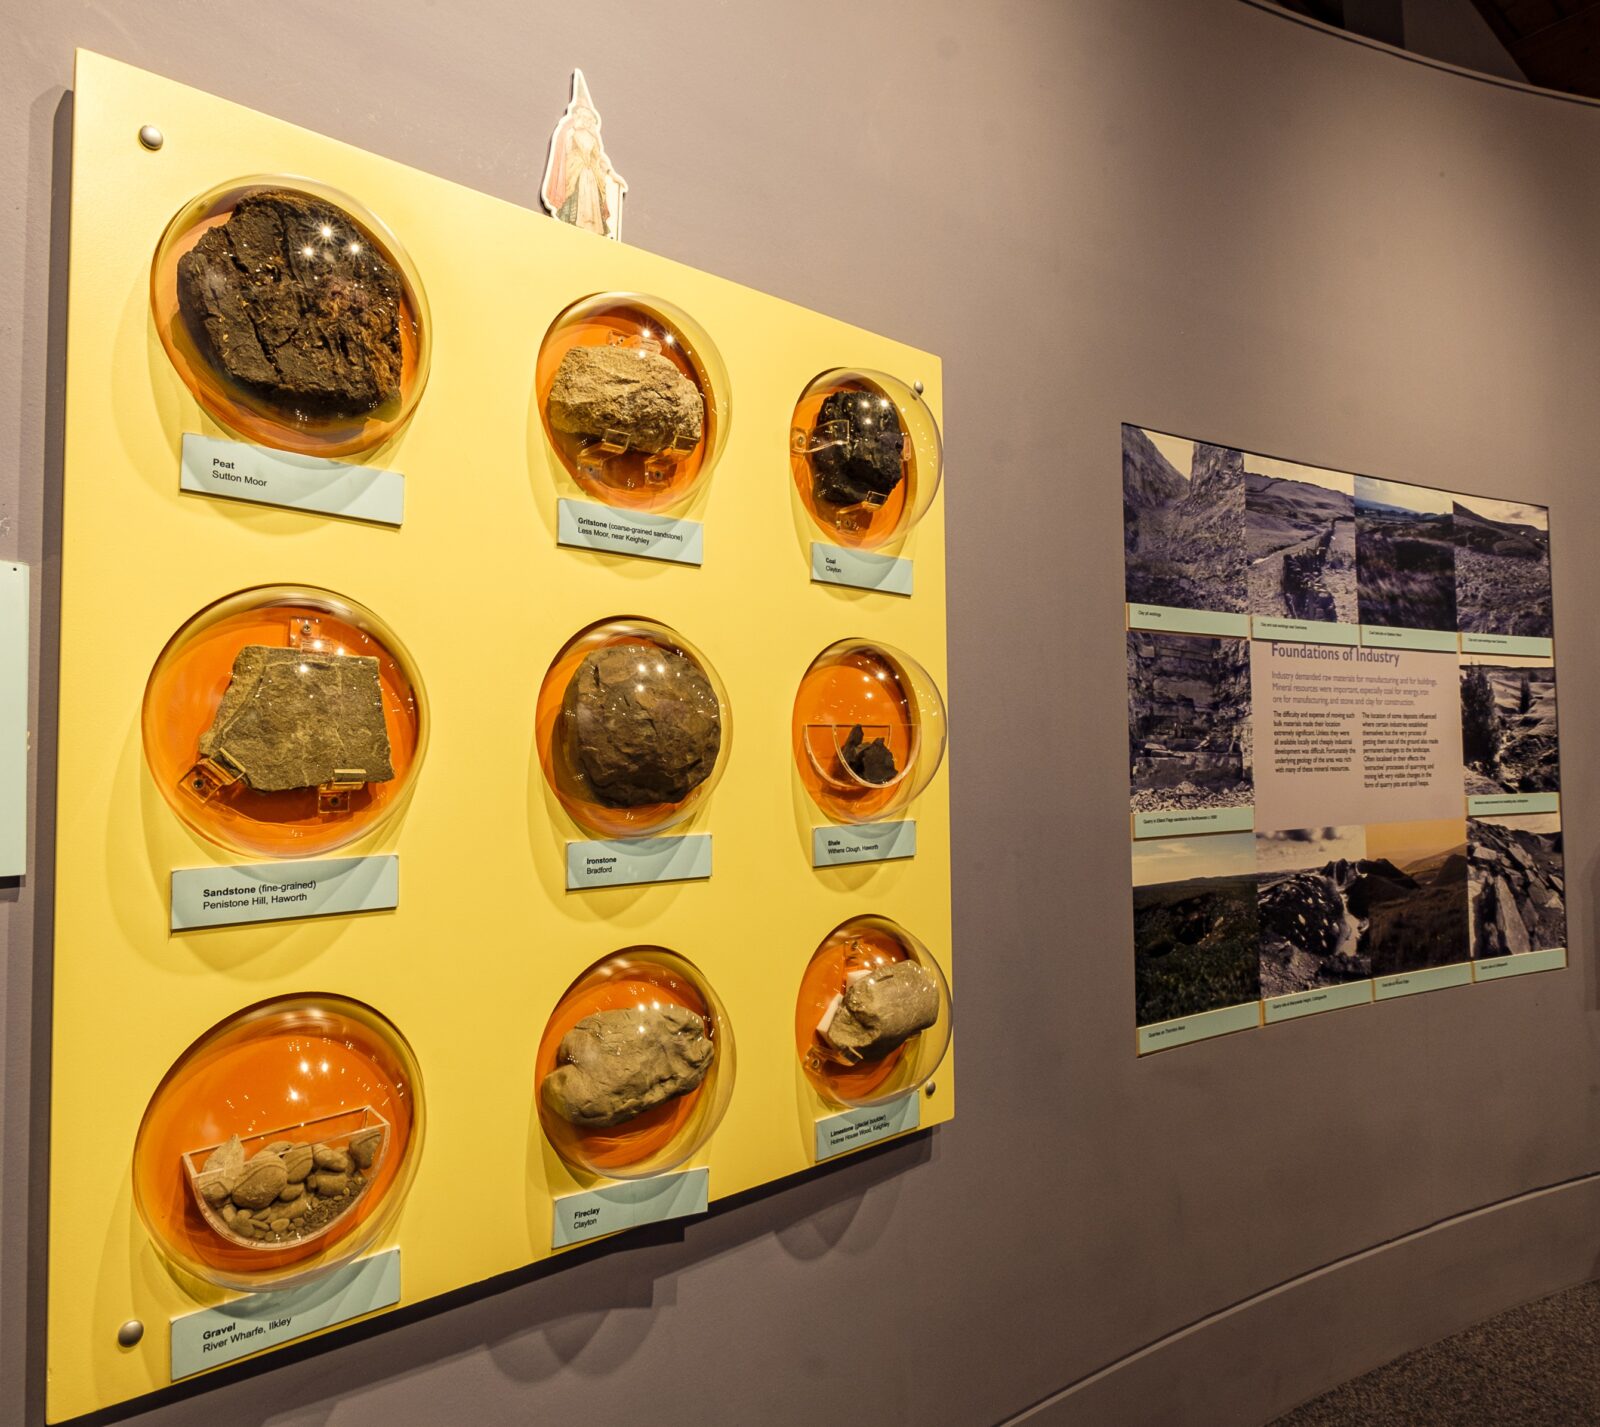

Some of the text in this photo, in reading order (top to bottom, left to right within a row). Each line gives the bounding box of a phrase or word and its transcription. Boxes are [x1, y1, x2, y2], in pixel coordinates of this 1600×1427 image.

[213, 458, 235, 470] Peat
[212, 470, 267, 487] Sutton Moor
[578, 518, 683, 542] Gritstone (coarse-grained sandstone)
[578, 527, 592, 535] Less
[594, 530, 610, 538] Moor,
[626, 535, 649, 545] Keighley
[1272, 642, 1400, 667] Foundations of Industry
[587, 866, 612, 874] Bradford
[203, 880, 316, 897] Sandstone (fine-grained)
[203, 893, 307, 910] Penistone Hill, Haworth
[831, 1126, 854, 1137] Limestone
[831, 1137, 844, 1145] Holme
[845, 1132, 858, 1140] House
[873, 1122, 890, 1131] Keighley
[574, 1208, 600, 1219] Fireclay
[574, 1218, 597, 1229] Clayton
[203, 1322, 236, 1340] Gravel
[203, 1317, 291, 1353] River Wharfe, Ilkley
